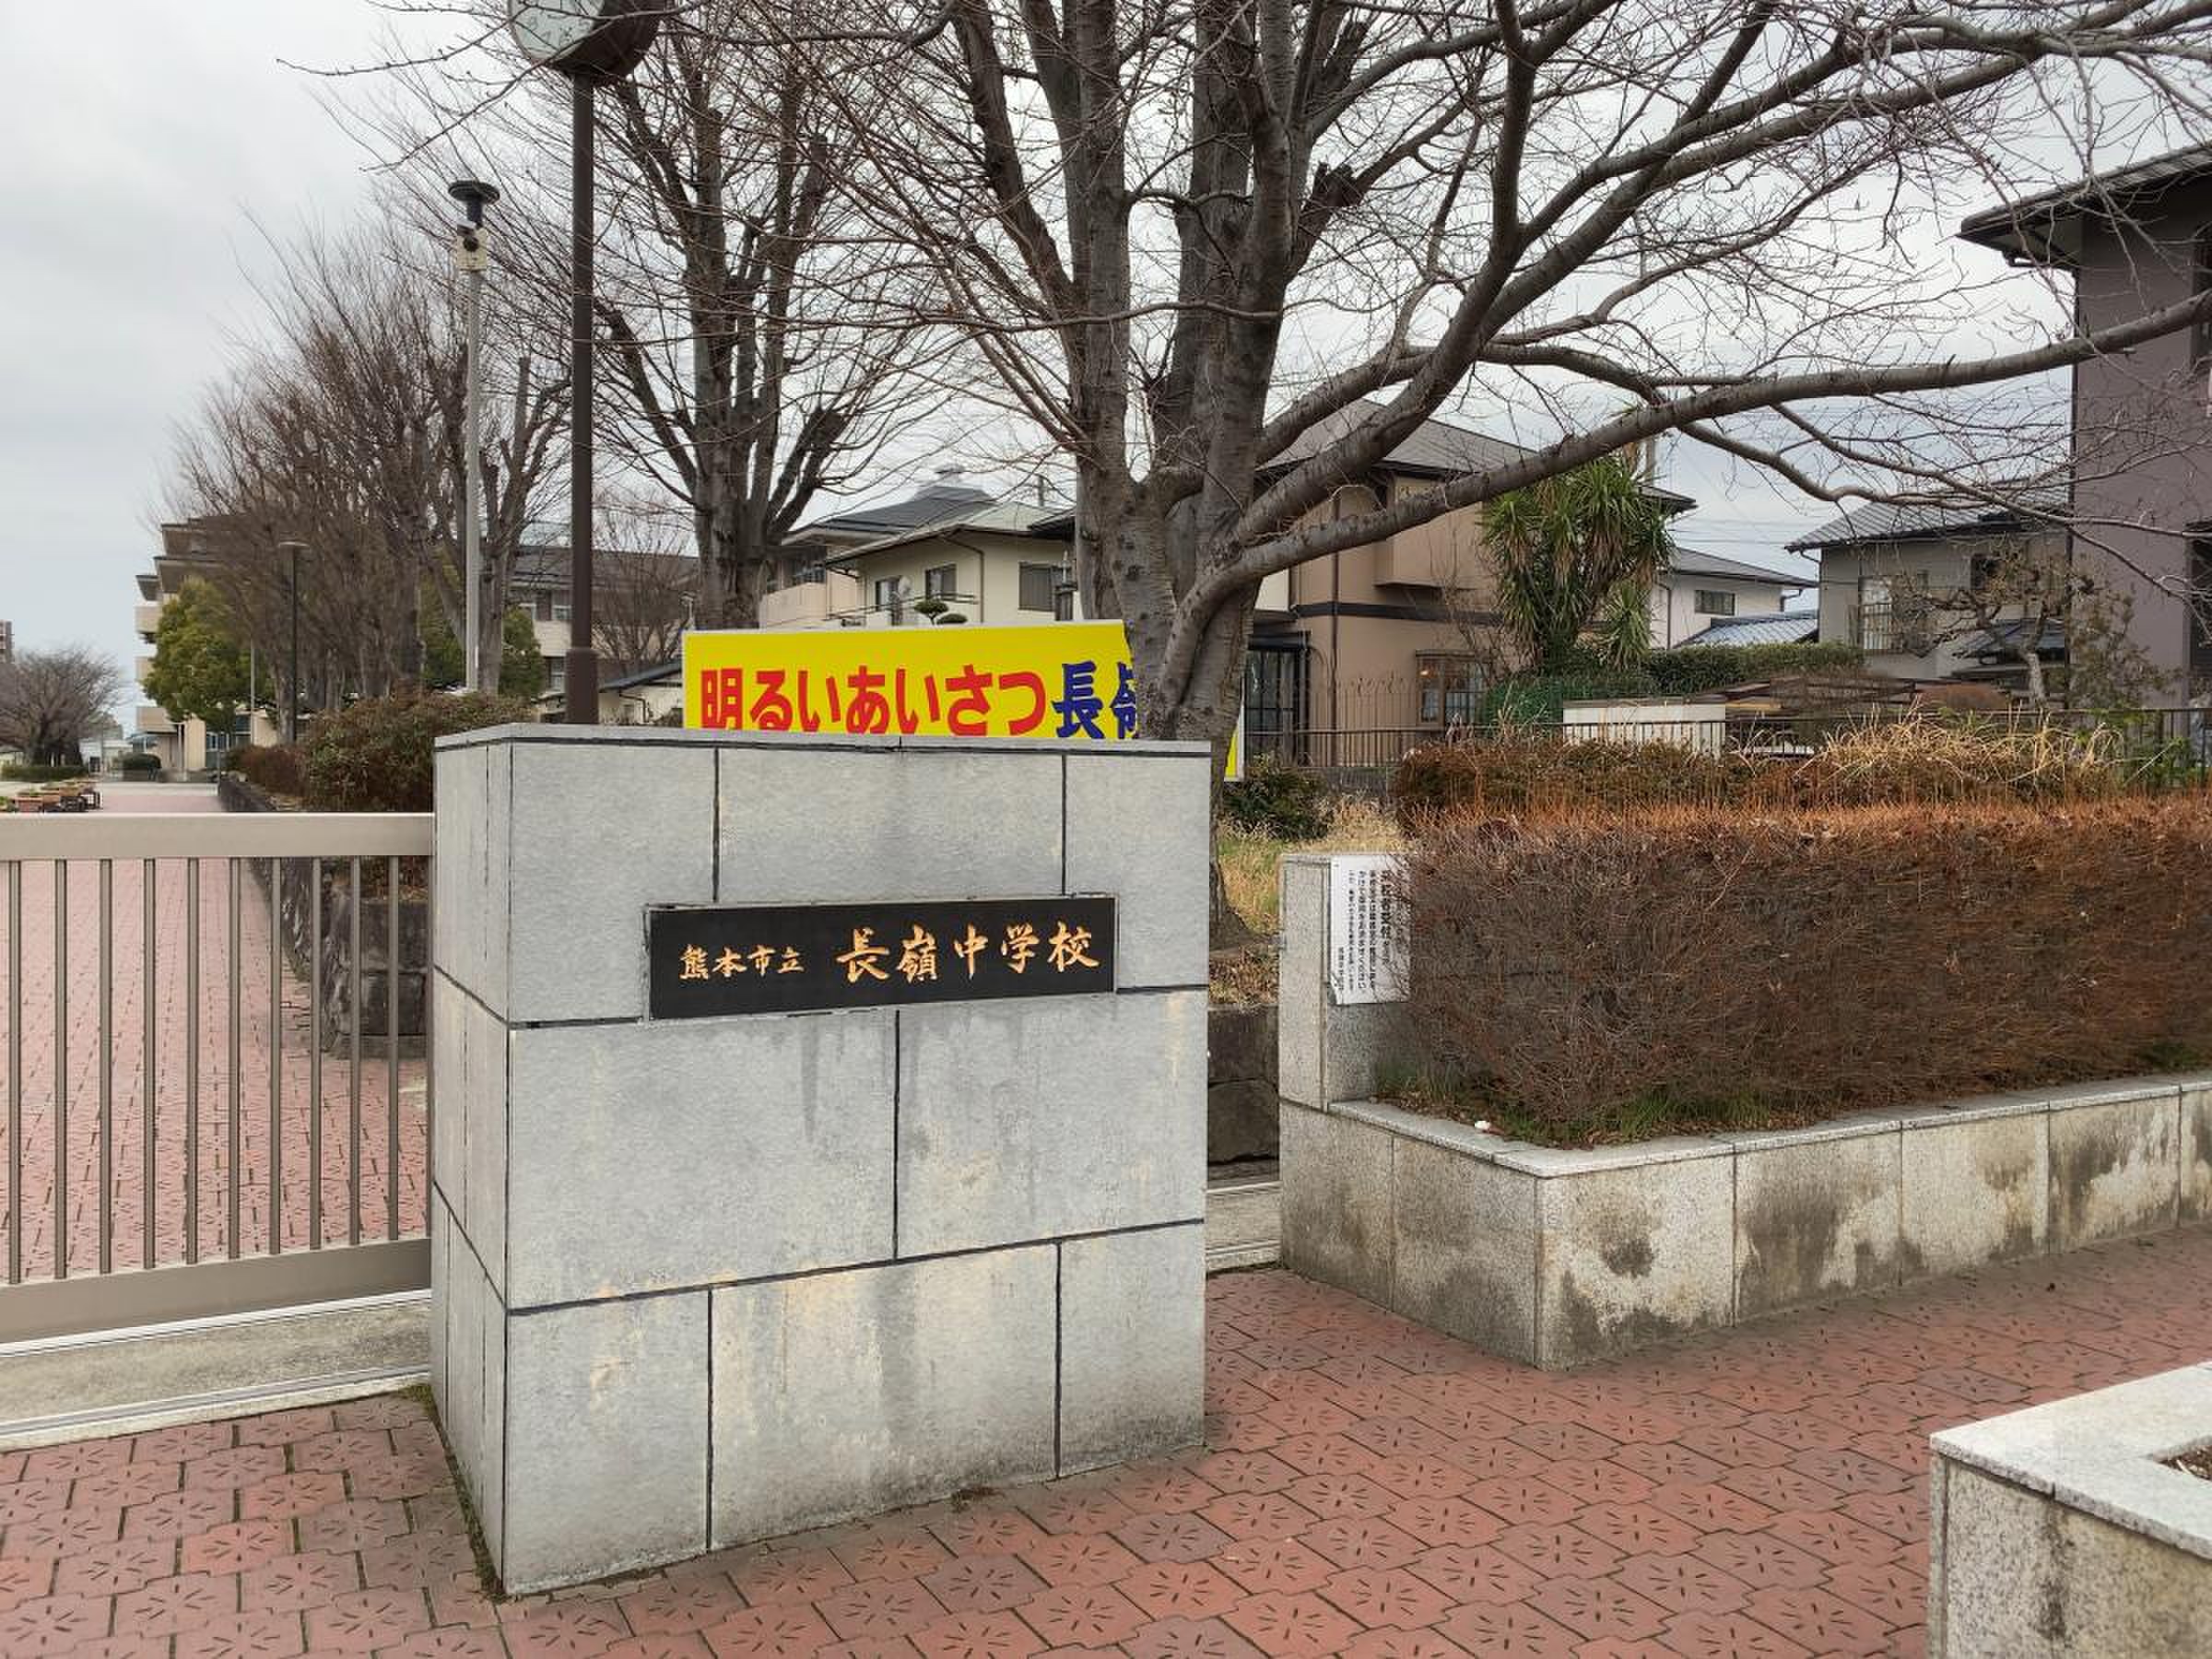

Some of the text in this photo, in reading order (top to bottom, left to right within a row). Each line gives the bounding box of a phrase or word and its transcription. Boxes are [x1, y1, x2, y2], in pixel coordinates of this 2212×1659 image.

[678, 921, 1100, 983] 熊本市立 長嶺中学校
